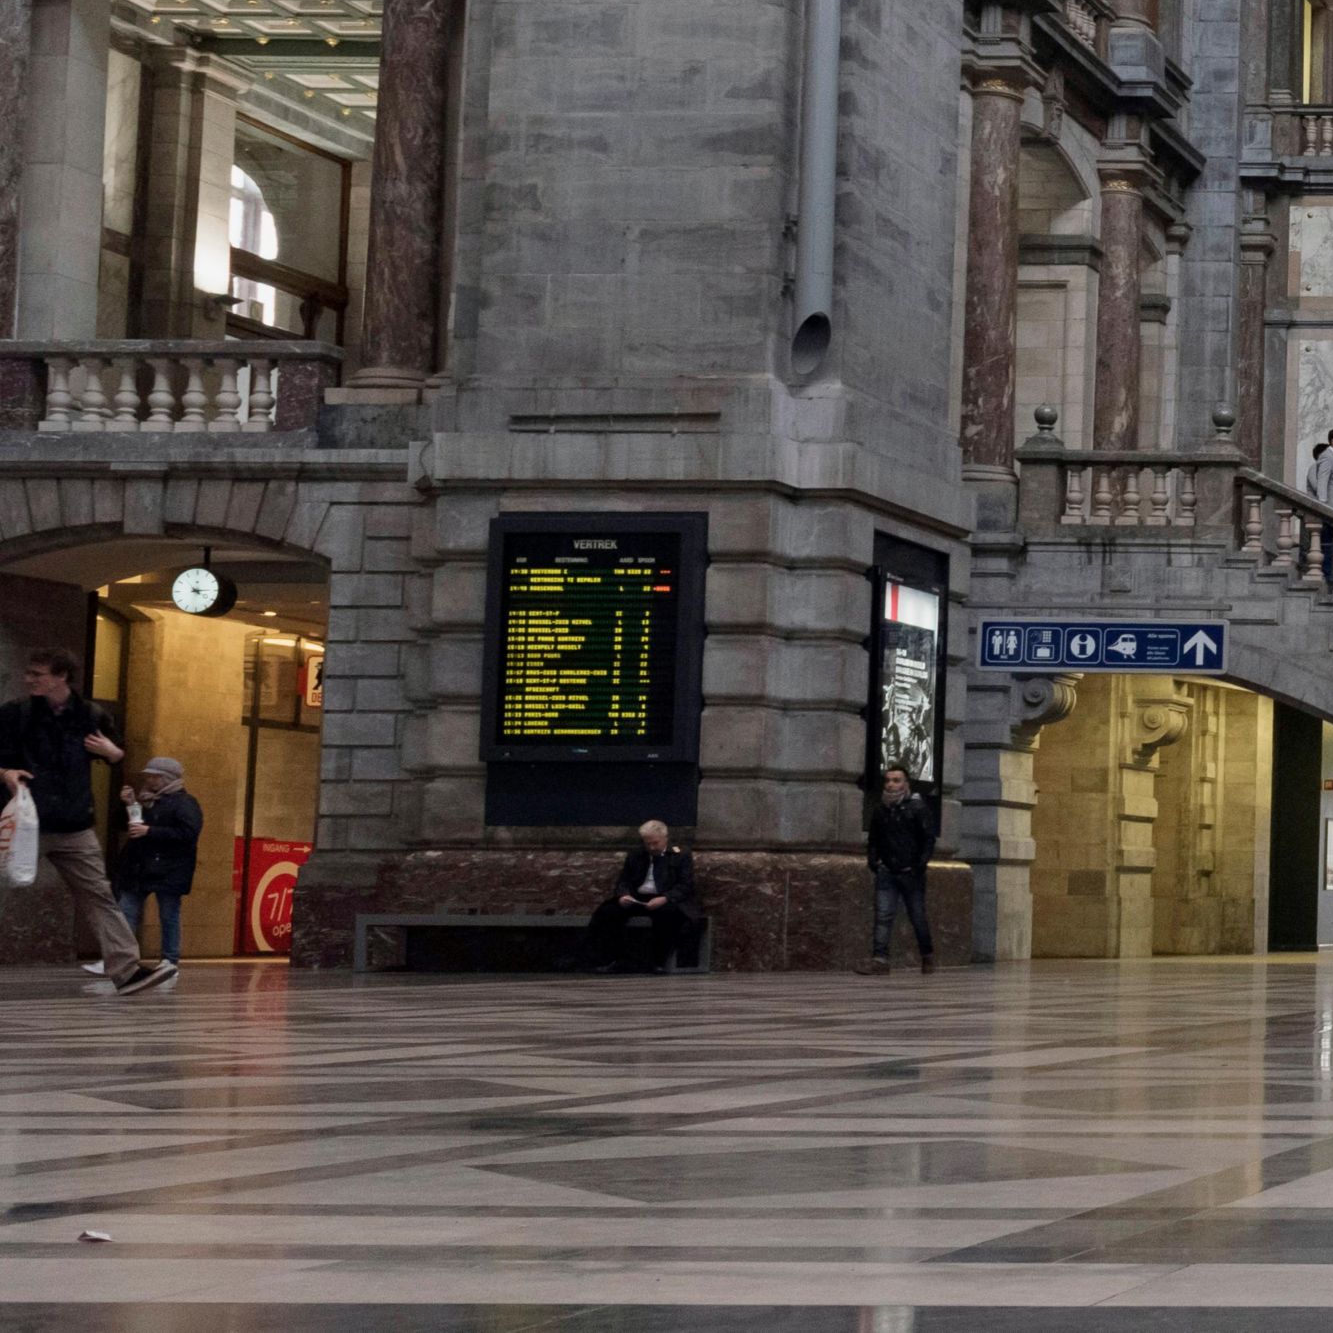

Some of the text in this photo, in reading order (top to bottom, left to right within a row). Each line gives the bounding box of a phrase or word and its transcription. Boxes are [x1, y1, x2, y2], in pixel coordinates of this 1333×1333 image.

[573, 539, 618, 550] VERTREK
[262, 843, 290, 853] INGANG
[272, 922, 292, 937] ope
